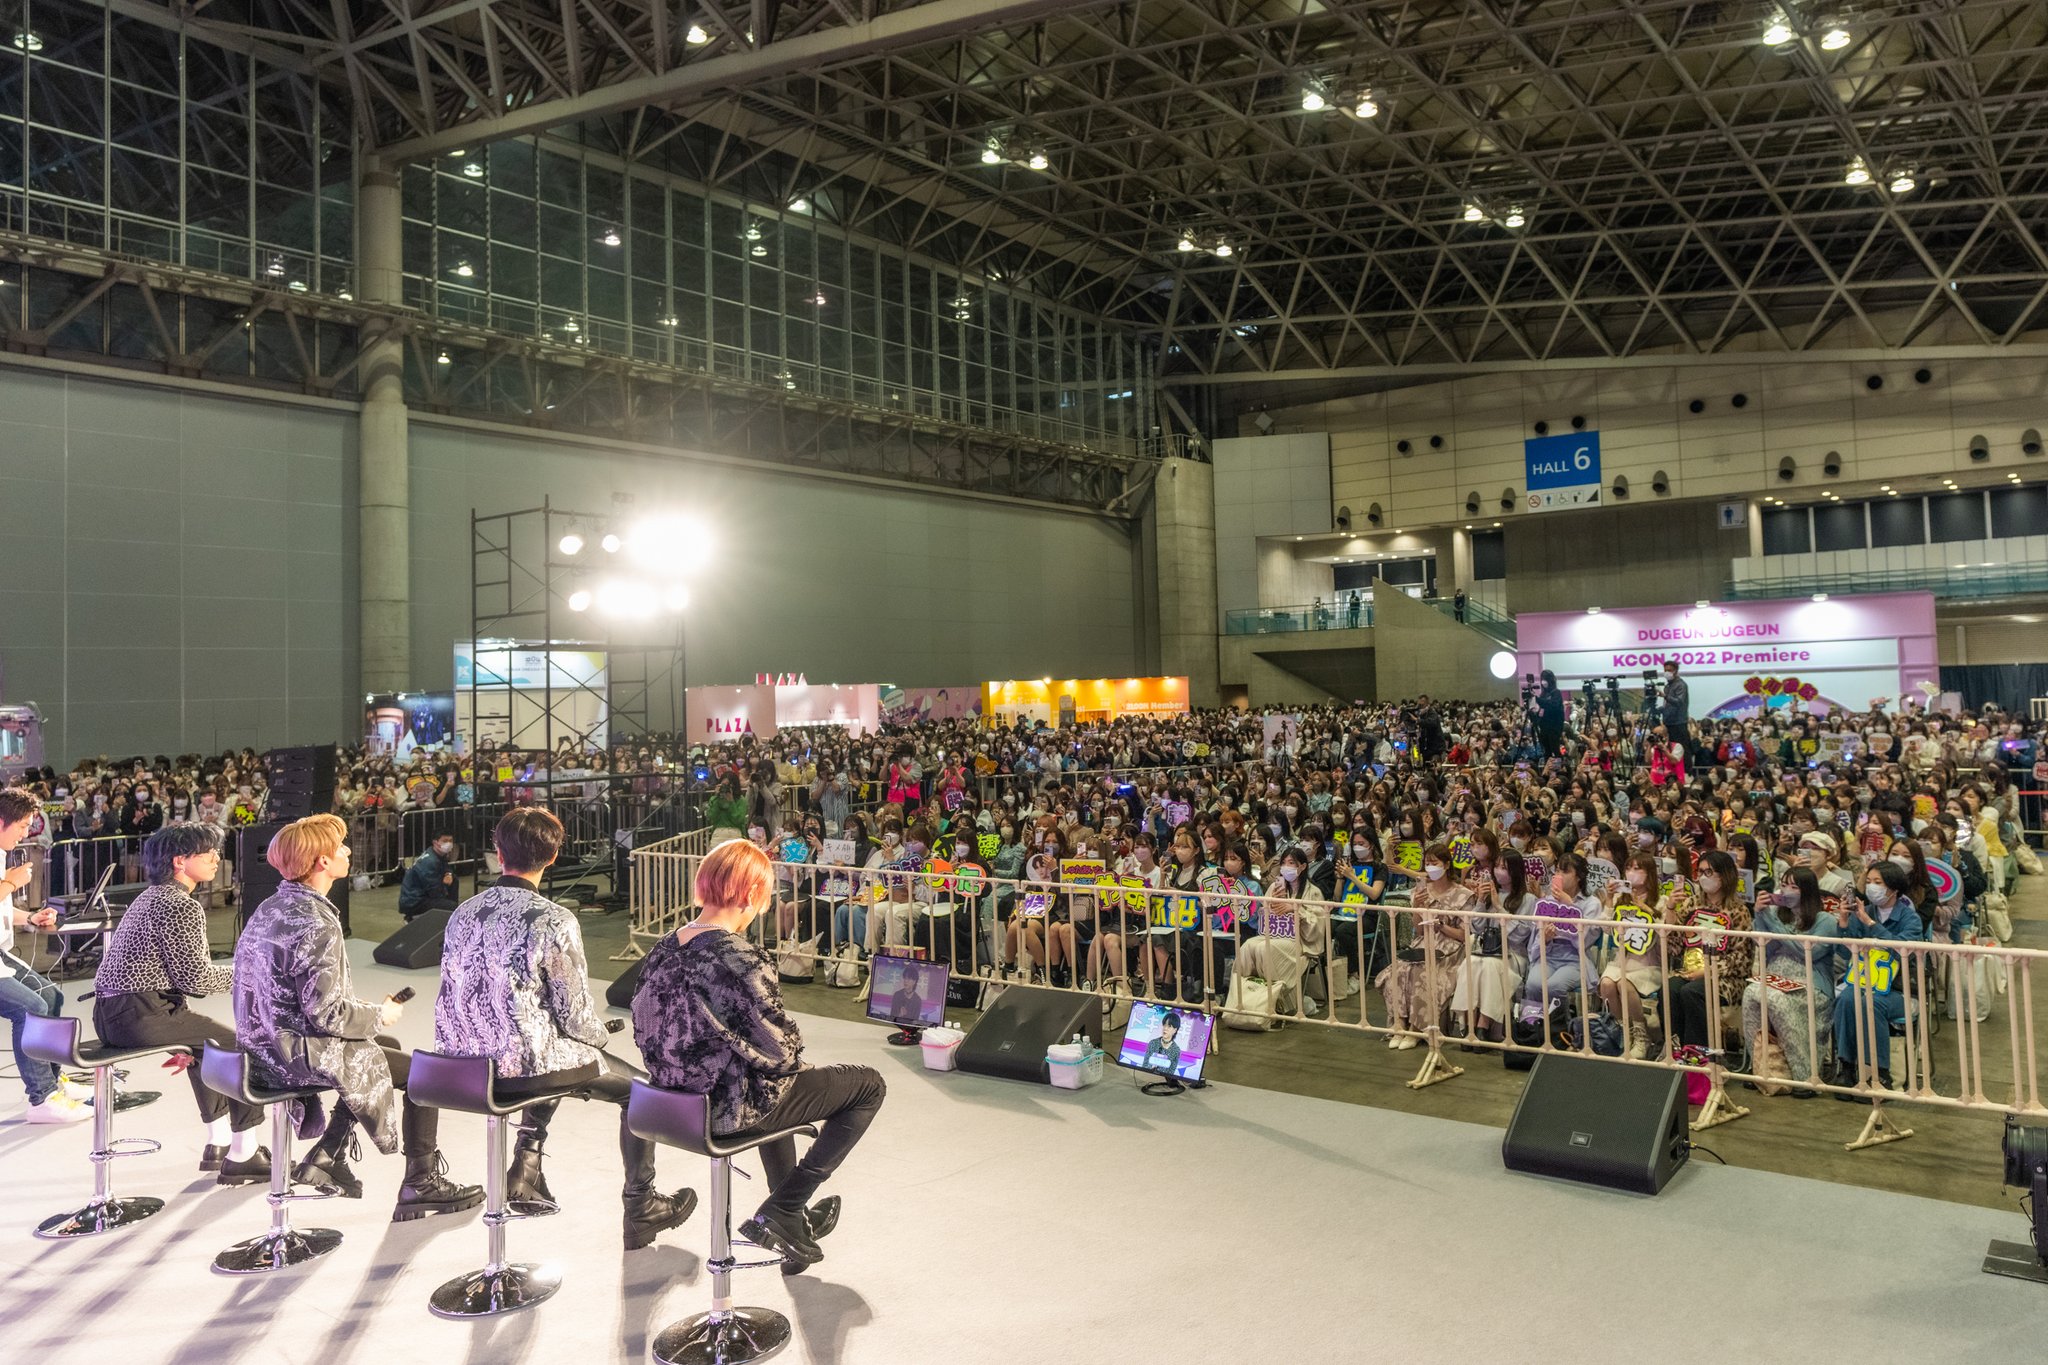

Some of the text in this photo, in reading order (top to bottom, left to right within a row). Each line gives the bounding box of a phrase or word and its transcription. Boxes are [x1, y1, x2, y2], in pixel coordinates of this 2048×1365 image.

[1532, 446, 1591, 476] HALL 6
[1638, 623, 1780, 641] DUGEUN DUGEUN
[1613, 647, 1810, 667] KCON 2022 Premiere
[755, 672, 808, 686] PLAZA
[706, 717, 753, 733] PLAZA
[1397, 841, 1423, 871] 秀
